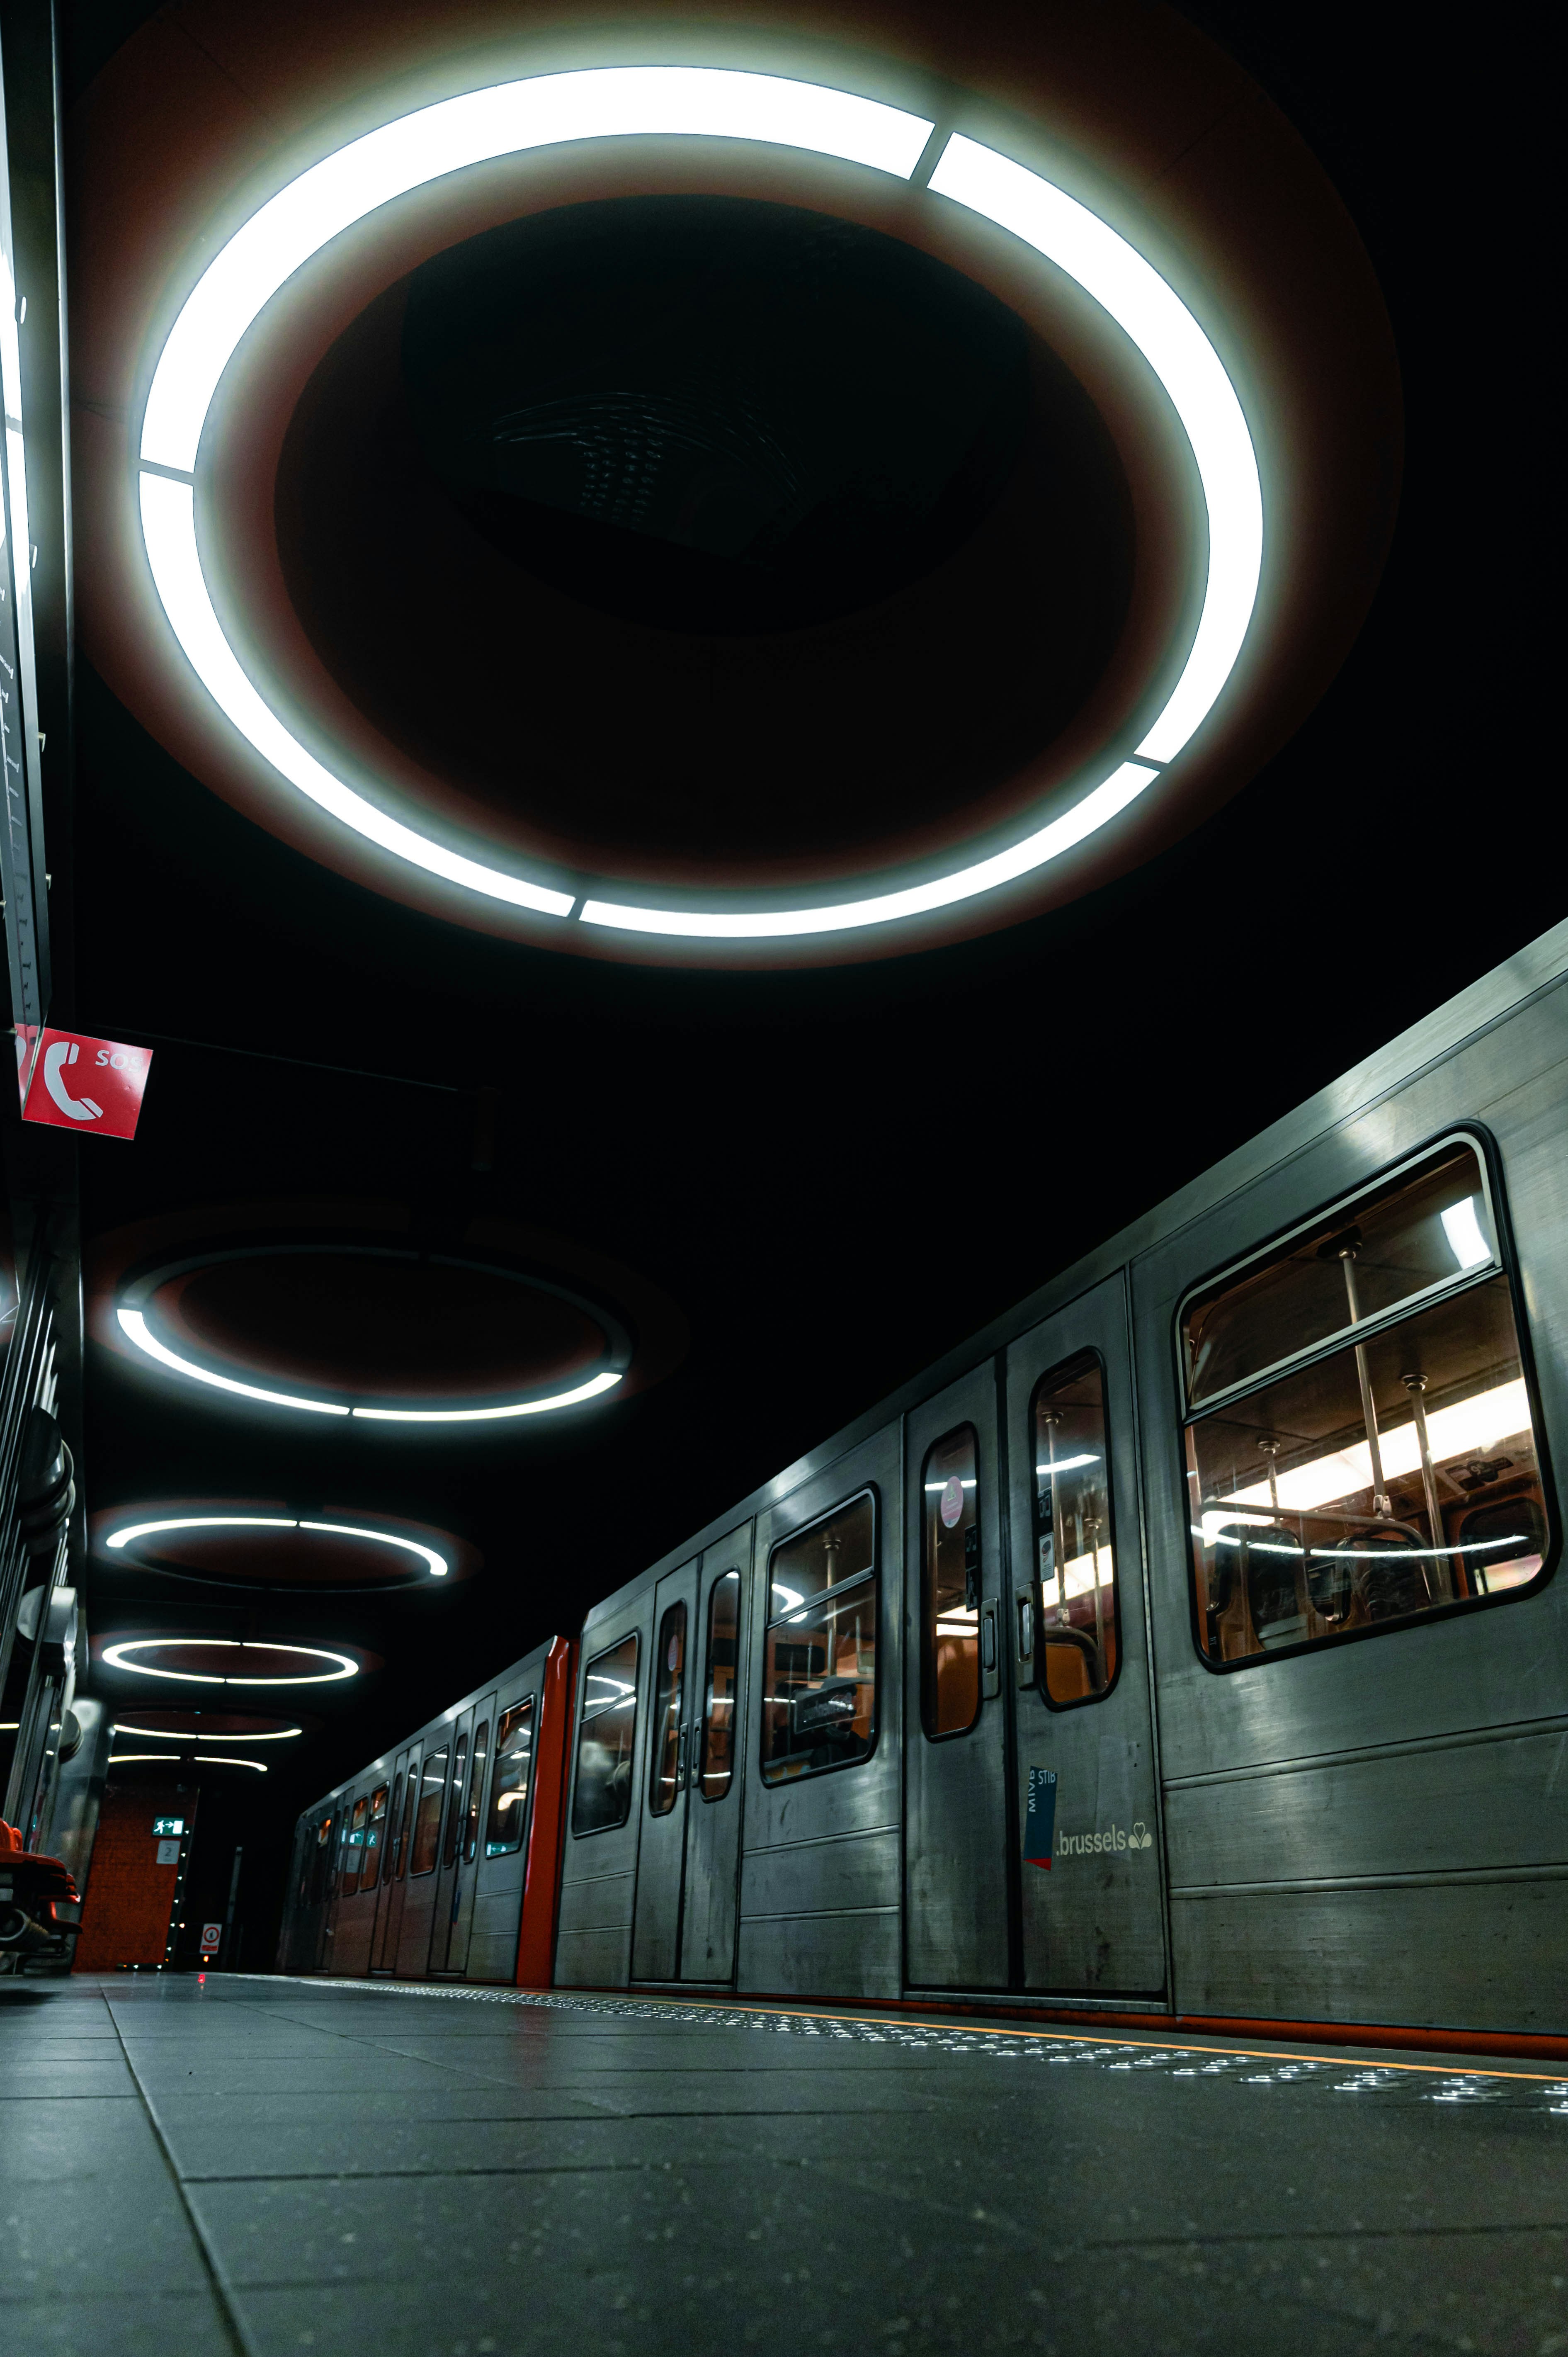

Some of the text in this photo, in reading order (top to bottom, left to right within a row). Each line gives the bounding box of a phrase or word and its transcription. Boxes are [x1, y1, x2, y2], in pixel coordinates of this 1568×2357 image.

[95, 1050, 143, 1072] SOS
[1056, 1824, 1126, 1856] .brussels
[165, 1847, 172, 1856] 2
